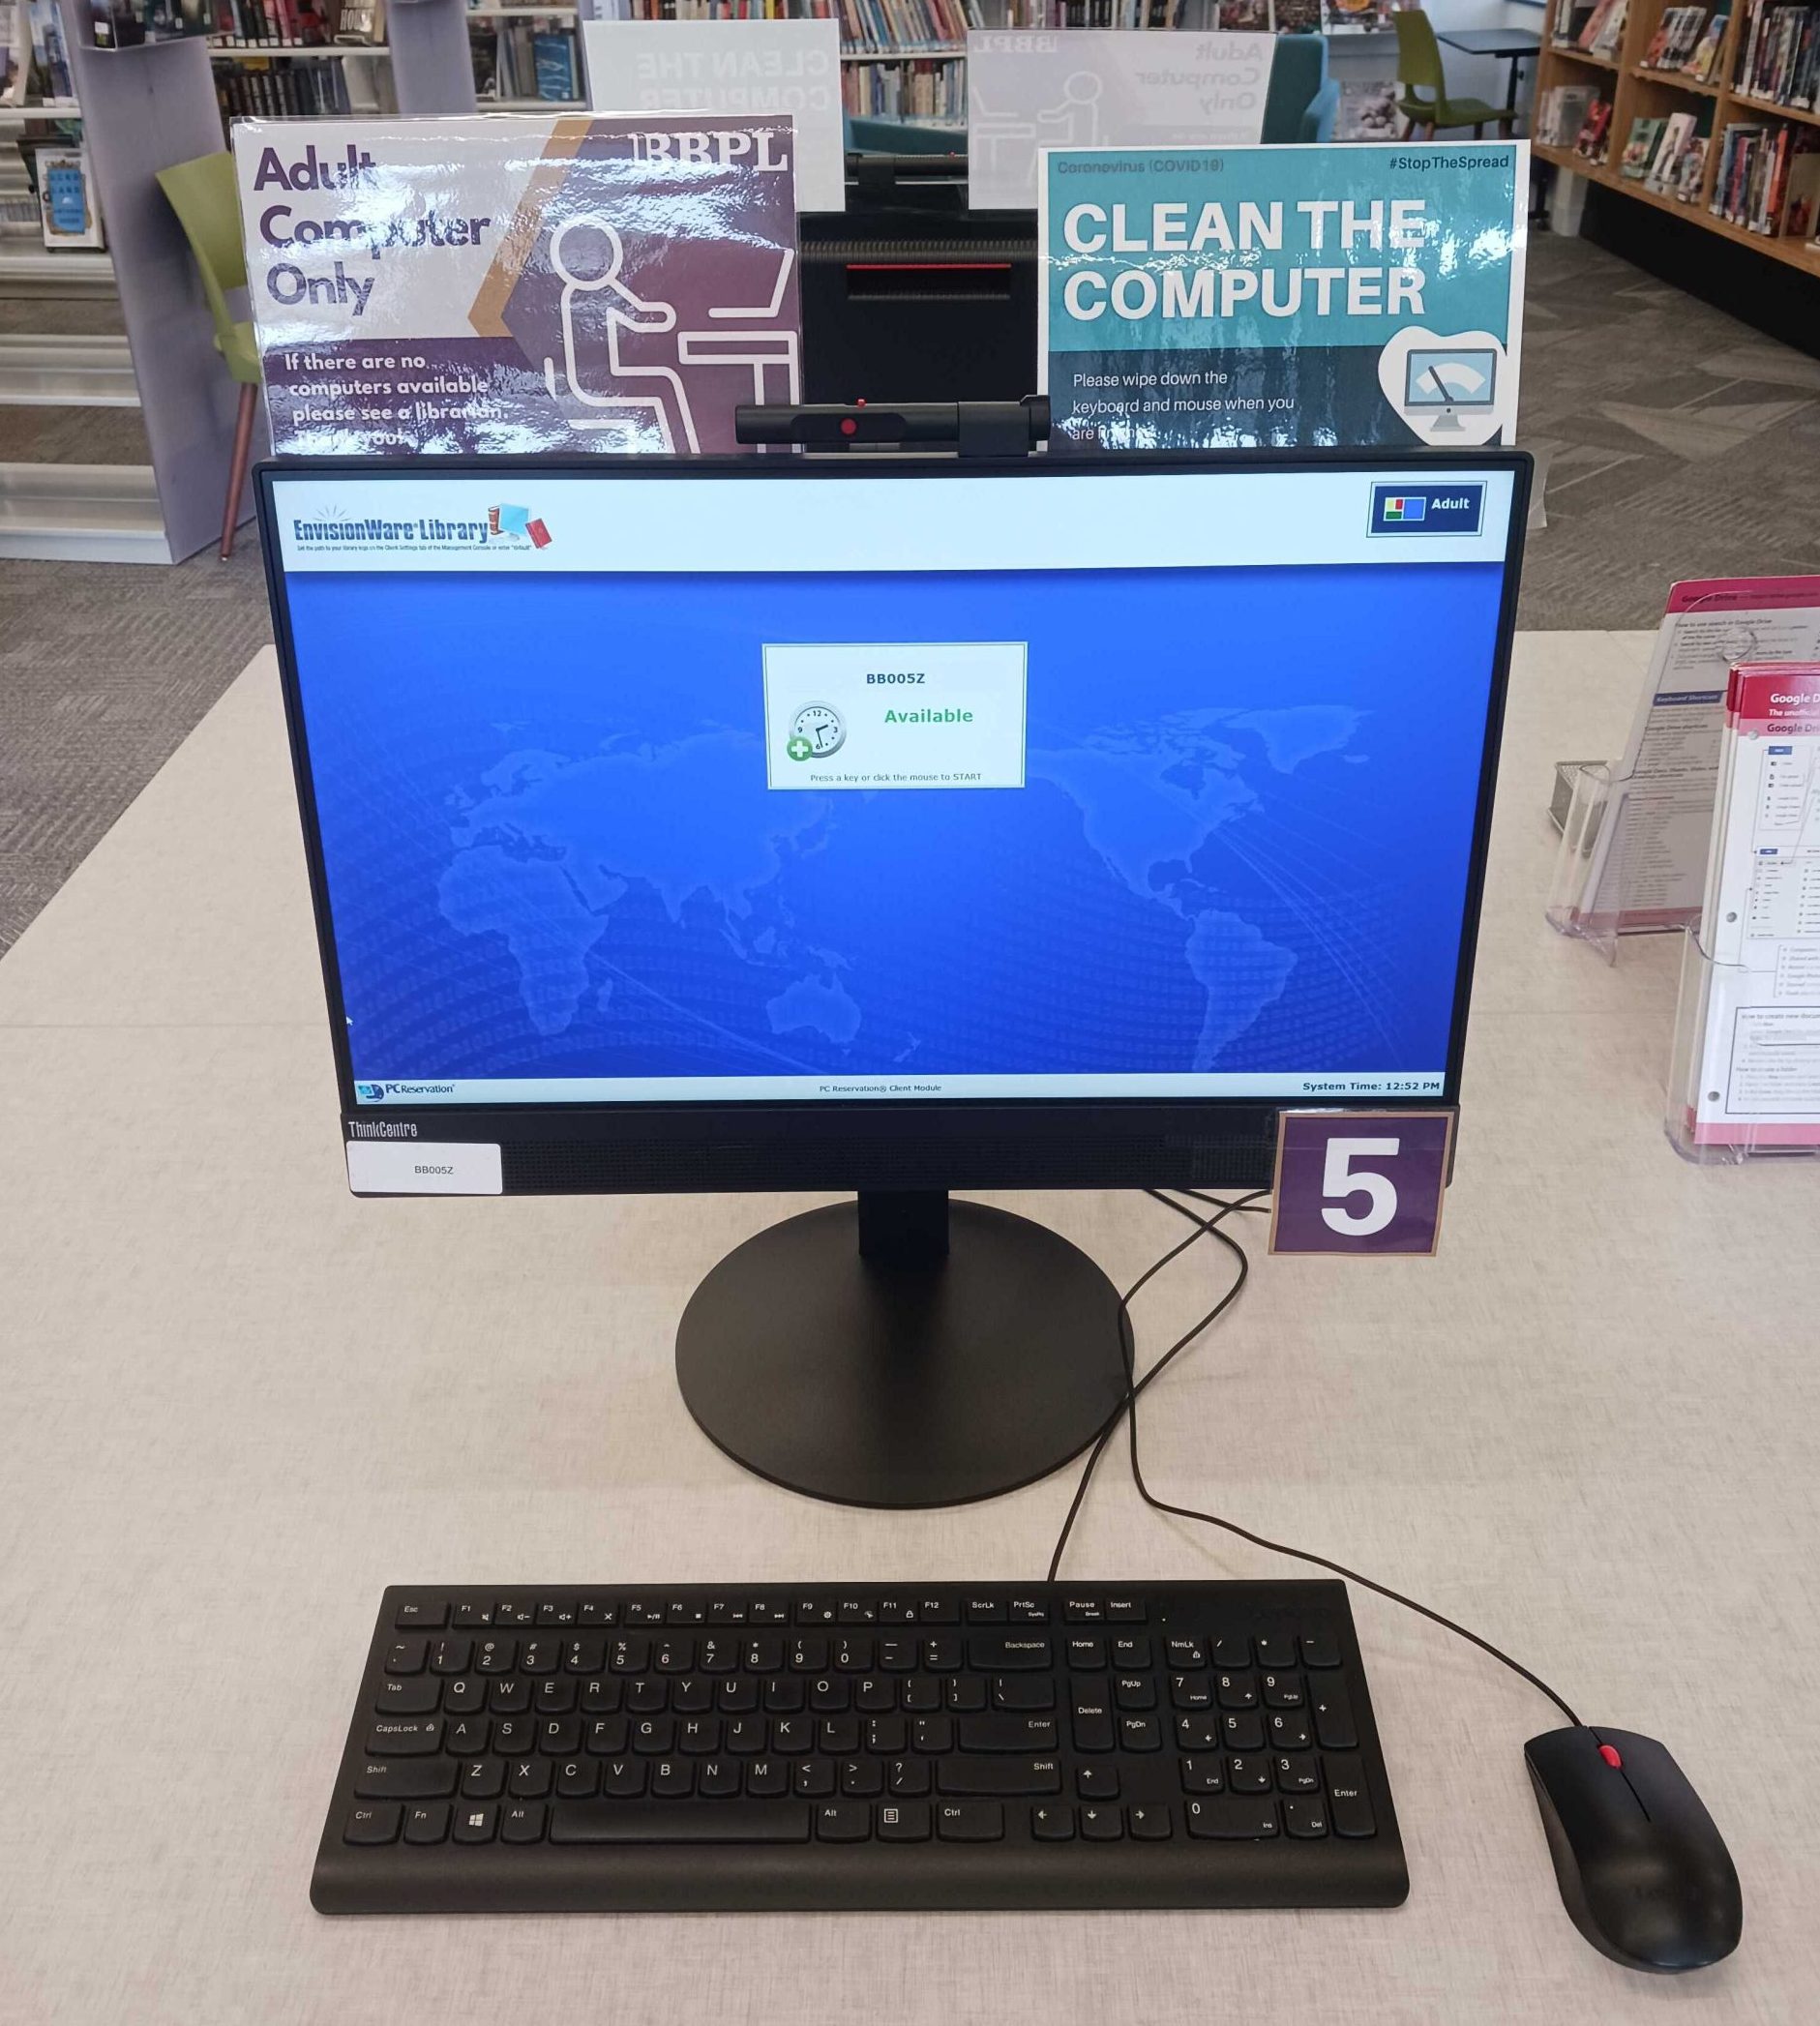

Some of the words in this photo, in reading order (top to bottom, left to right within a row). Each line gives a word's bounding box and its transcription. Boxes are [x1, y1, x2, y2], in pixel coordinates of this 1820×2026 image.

[632, 132, 789, 172] BBPL
[254, 144, 375, 192] Adult
[1388, 154, 1510, 172] #StopTheSpread
[1063, 201, 1285, 254] CLEAN
[1297, 198, 1427, 251] THE
[266, 261, 375, 316] Only
[1063, 266, 1427, 322] COMPUTER
[284, 353, 299, 371] If
[304, 352, 357, 371] there
[362, 355, 396, 370] are
[402, 355, 426, 370] no
[1073, 373, 1119, 388] Please
[1122, 372, 1157, 389] wipe
[1159, 371, 1201, 386] down
[1204, 370, 1228, 385] the
[290, 374, 392, 402] computers
[397, 374, 489, 396] available
[1072, 399, 1139, 418] keyboard
[1142, 398, 1170, 412] and
[1174, 400, 1222, 412] mouse
[1224, 397, 1265, 410] when
[1268, 398, 1295, 413] you
[293, 402, 356, 427] please
[361, 405, 393, 422] see
[398, 406, 411, 421] a
[1072, 429, 1094, 440] are
[1431, 497, 1471, 510] Adult
[418, 519, 489, 544] Library
[866, 672, 926, 685] BB005Z
[1771, 693, 1810, 705] Google
[884, 708, 974, 724] Available
[1767, 723, 1803, 735] Google
[810, 773, 835, 783] Press
[844, 773, 859, 784] key
[873, 773, 891, 783] click
[893, 773, 909, 782] the
[940, 773, 951, 782] to
[952, 772, 982, 782] START
[820, 1085, 831, 1093] PC
[889, 1084, 912, 1092] Client
[913, 1084, 942, 1092] Module
[1302, 1082, 1346, 1092] System
[1350, 1082, 1383, 1091] Time:
[1386, 1082, 1419, 1091] 12:52
[1422, 1081, 1441, 1091] PM
[347, 1119, 419, 1139] ThinkCentre
[414, 1165, 455, 1176] BB005Z
[1320, 1136, 1401, 1237] 5
[437, 1654, 443, 1665] 1
[482, 1654, 492, 1666] 2
[526, 1654, 535, 1665] 3
[570, 1654, 579, 1665] 4
[615, 1654, 625, 1665] 5
[661, 1654, 670, 1664] 6
[706, 1653, 715, 1664] 7
[750, 1653, 759, 1664] 8
[795, 1653, 804, 1663] 9
[840, 1653, 850, 1663] 0
[453, 1682, 465, 1693] Q
[499, 1683, 515, 1694] W
[544, 1682, 555, 1693] E
[589, 1682, 600, 1693] R
[635, 1682, 645, 1693] T
[681, 1682, 692, 1692] Y
[726, 1682, 737, 1693] U
[817, 1680, 829, 1692] O
[863, 1681, 874, 1692] P
[1121, 1680, 1142, 1688] PgUp
[375, 1724, 418, 1734] CapsLock
[456, 1723, 466, 1734] A
[501, 1722, 513, 1735] S
[548, 1722, 559, 1734] D
[595, 1722, 605, 1734] F
[641, 1722, 652, 1734] G
[687, 1722, 699, 1734] H
[732, 1722, 742, 1734] J
[780, 1721, 791, 1734] K
[826, 1721, 835, 1734] L
[1126, 1720, 1147, 1729] PgDn
[366, 1765, 387, 1773] Shift
[470, 1764, 483, 1776] Z
[519, 1764, 530, 1776] X
[565, 1764, 577, 1776] C
[612, 1764, 624, 1775] V
[660, 1764, 671, 1776] B
[706, 1764, 718, 1775] N
[755, 1764, 767, 1775] M
[1033, 1762, 1054, 1771] Shift
[355, 1810, 373, 1820] Ctrl
[414, 1810, 427, 1819] Fn
[824, 1808, 837, 1817] Alt
[943, 1807, 961, 1817] Ctrl
